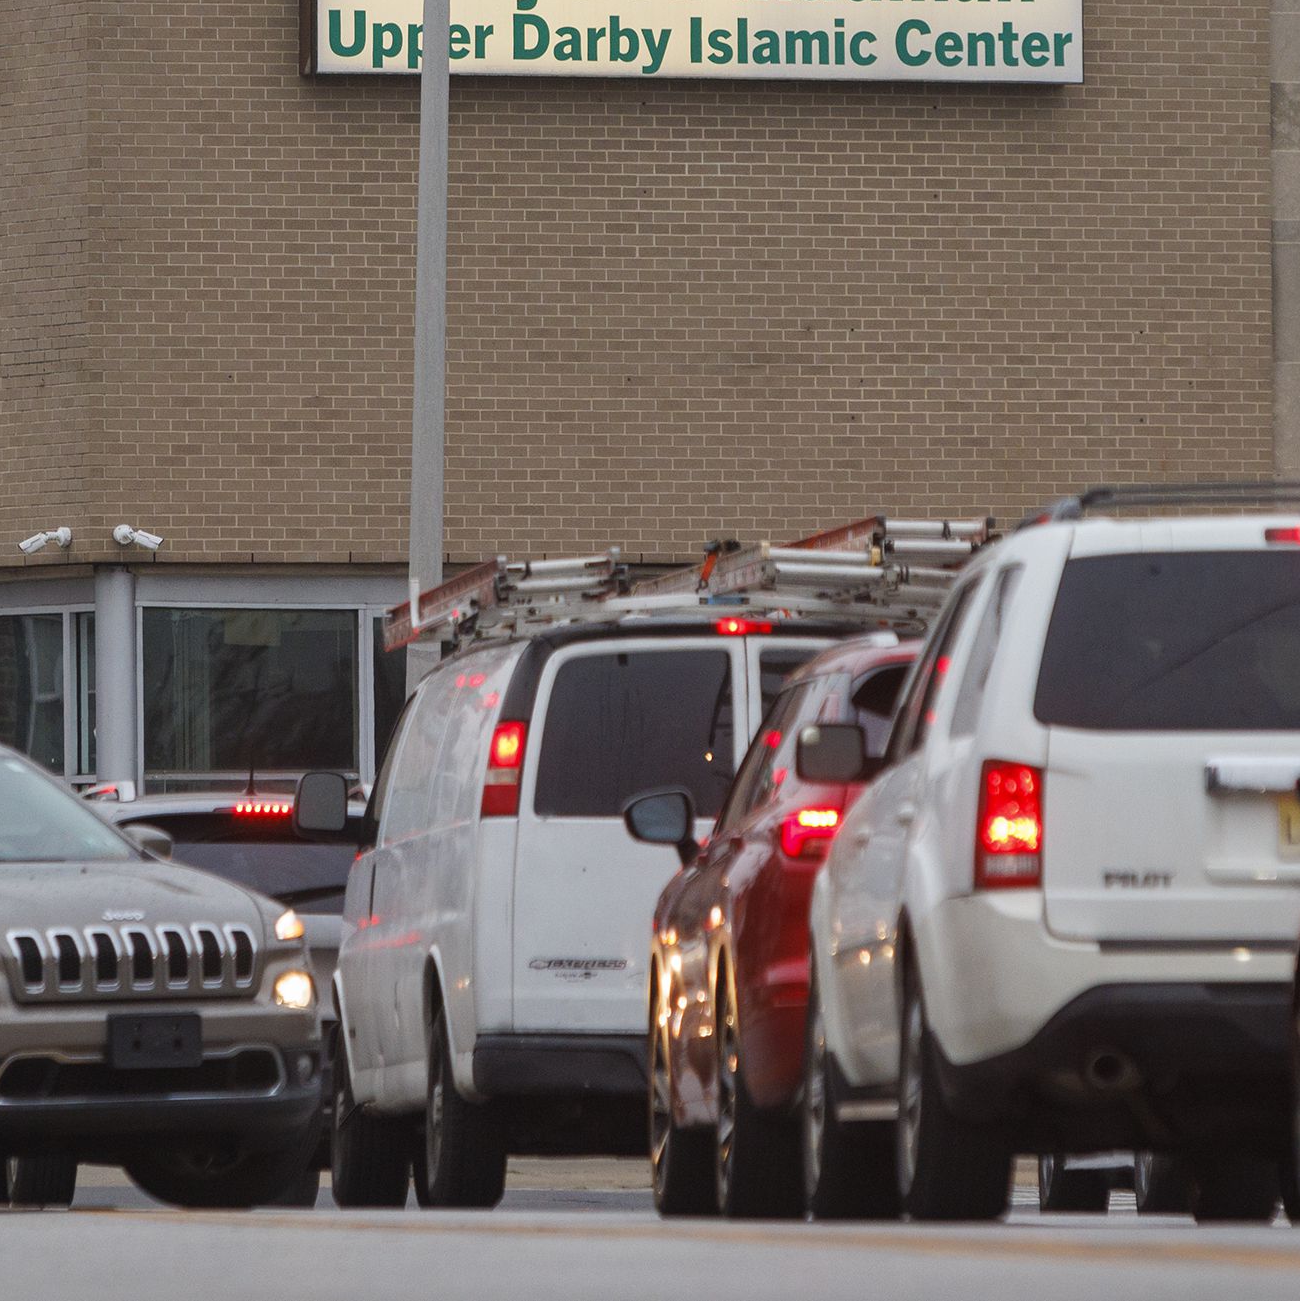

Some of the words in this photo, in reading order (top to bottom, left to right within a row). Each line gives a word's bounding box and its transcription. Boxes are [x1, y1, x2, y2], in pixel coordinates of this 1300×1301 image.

[512, 13, 672, 74] Darby
[690, 17, 877, 67] Islamic
[895, 18, 1073, 68] Center
